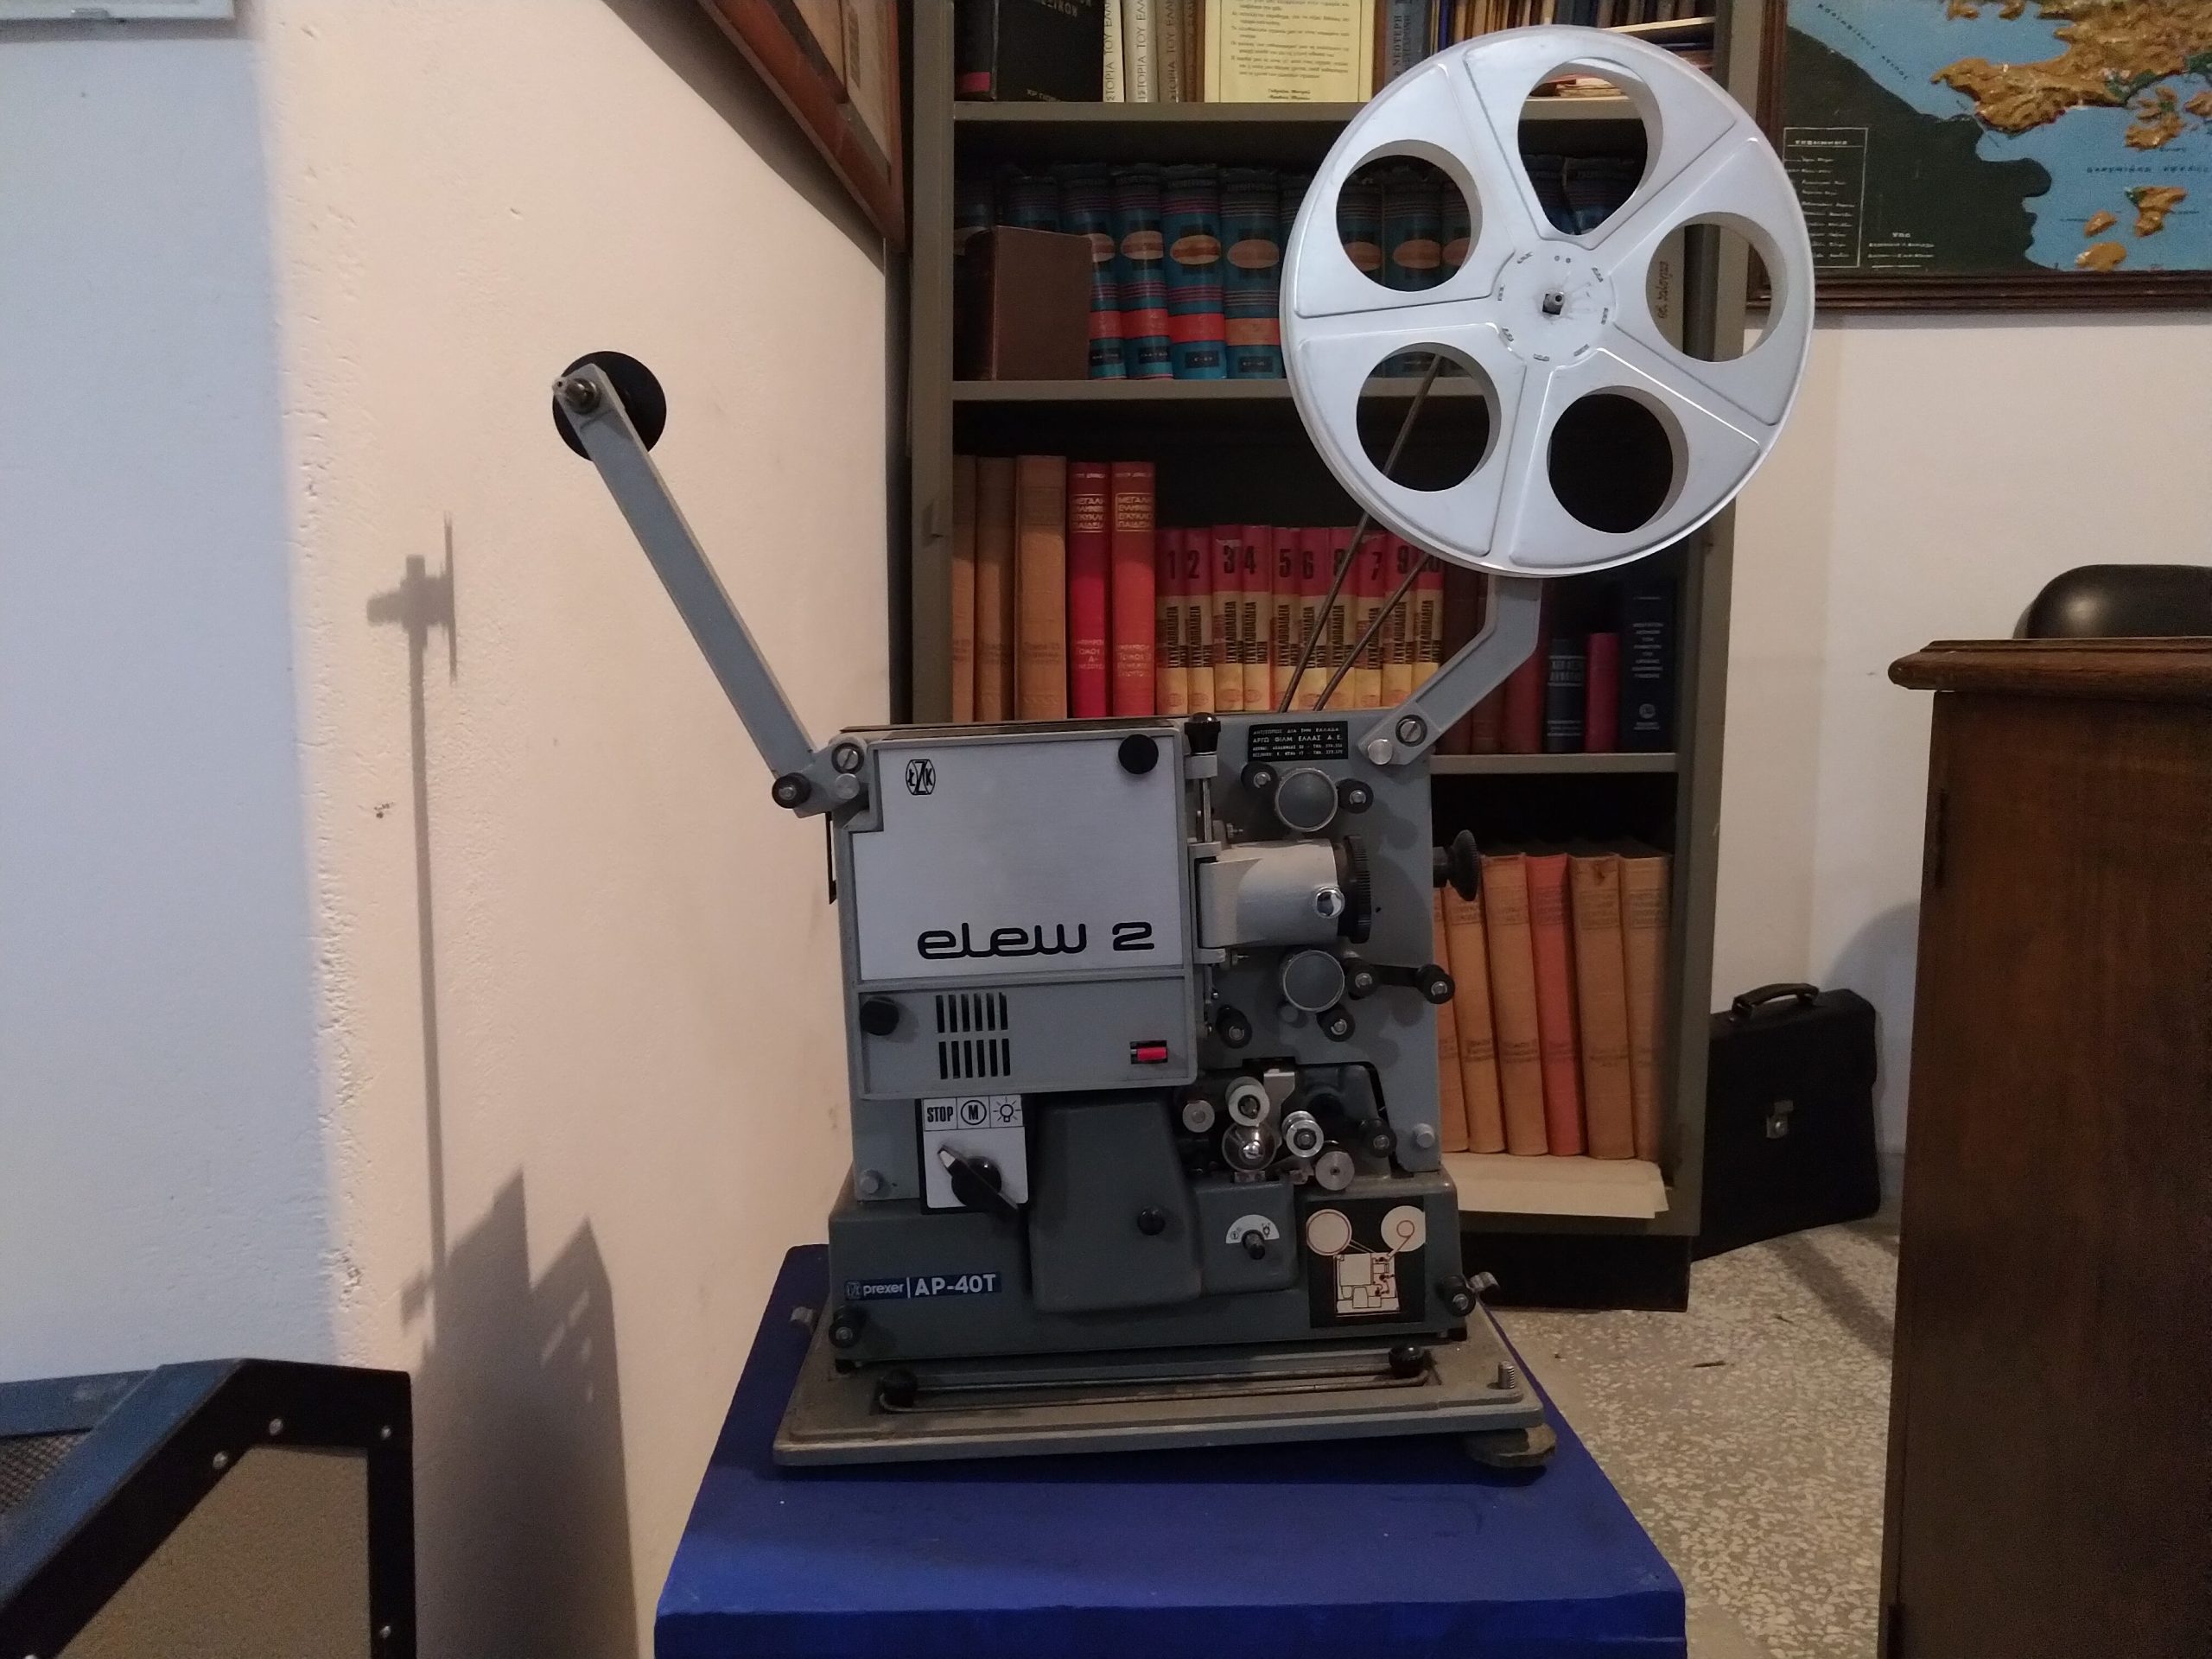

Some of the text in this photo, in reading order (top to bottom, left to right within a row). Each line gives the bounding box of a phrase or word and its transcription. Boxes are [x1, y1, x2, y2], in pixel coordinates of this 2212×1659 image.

[1103, 34, 1113, 55] ΤΟΥ
[1136, 27, 1147, 48] ΤΟΥ
[1105, 61, 1115, 101] ΣΤΟΡΙΑ
[1136, 55, 1147, 99] ΙΣΤΟΡΙΑ
[1167, 61, 1177, 100] ΣΤΟΡΙΑ
[1168, 550, 1176, 579] 1
[1188, 550, 1199, 579] 2
[1224, 545, 1236, 574] 3
[1244, 546, 1256, 575] 4
[1279, 549, 1291, 578] 5
[1302, 550, 1314, 579] 6
[1371, 551, 1382, 581] 7
[1397, 545, 1409, 574] 9
[917, 921, 1154, 960] elew 2
[927, 1107, 954, 1122] STOP
[968, 1105, 979, 1121] M
[863, 1274, 996, 1296] prexer AP-40T
